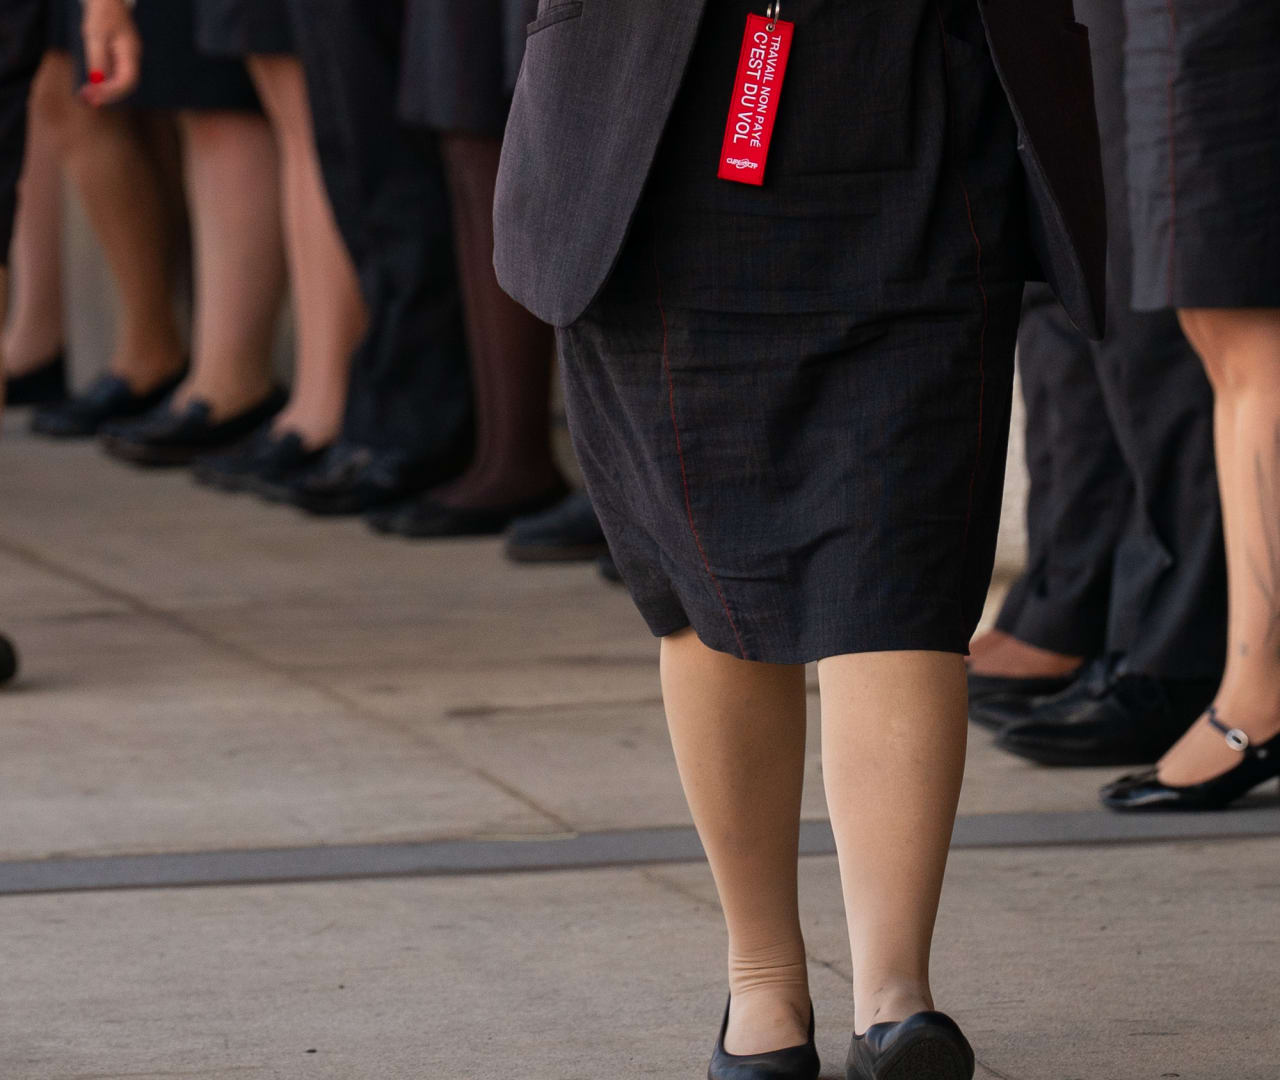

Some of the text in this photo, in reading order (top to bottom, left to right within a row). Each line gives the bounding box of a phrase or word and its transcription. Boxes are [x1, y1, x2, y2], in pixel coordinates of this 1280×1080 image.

[746, 32, 768, 80] C'EST
[741, 83, 758, 108] DU
[750, 35, 781, 147] TRAVAIL NON PAYÉ
[733, 111, 753, 144] VOL
